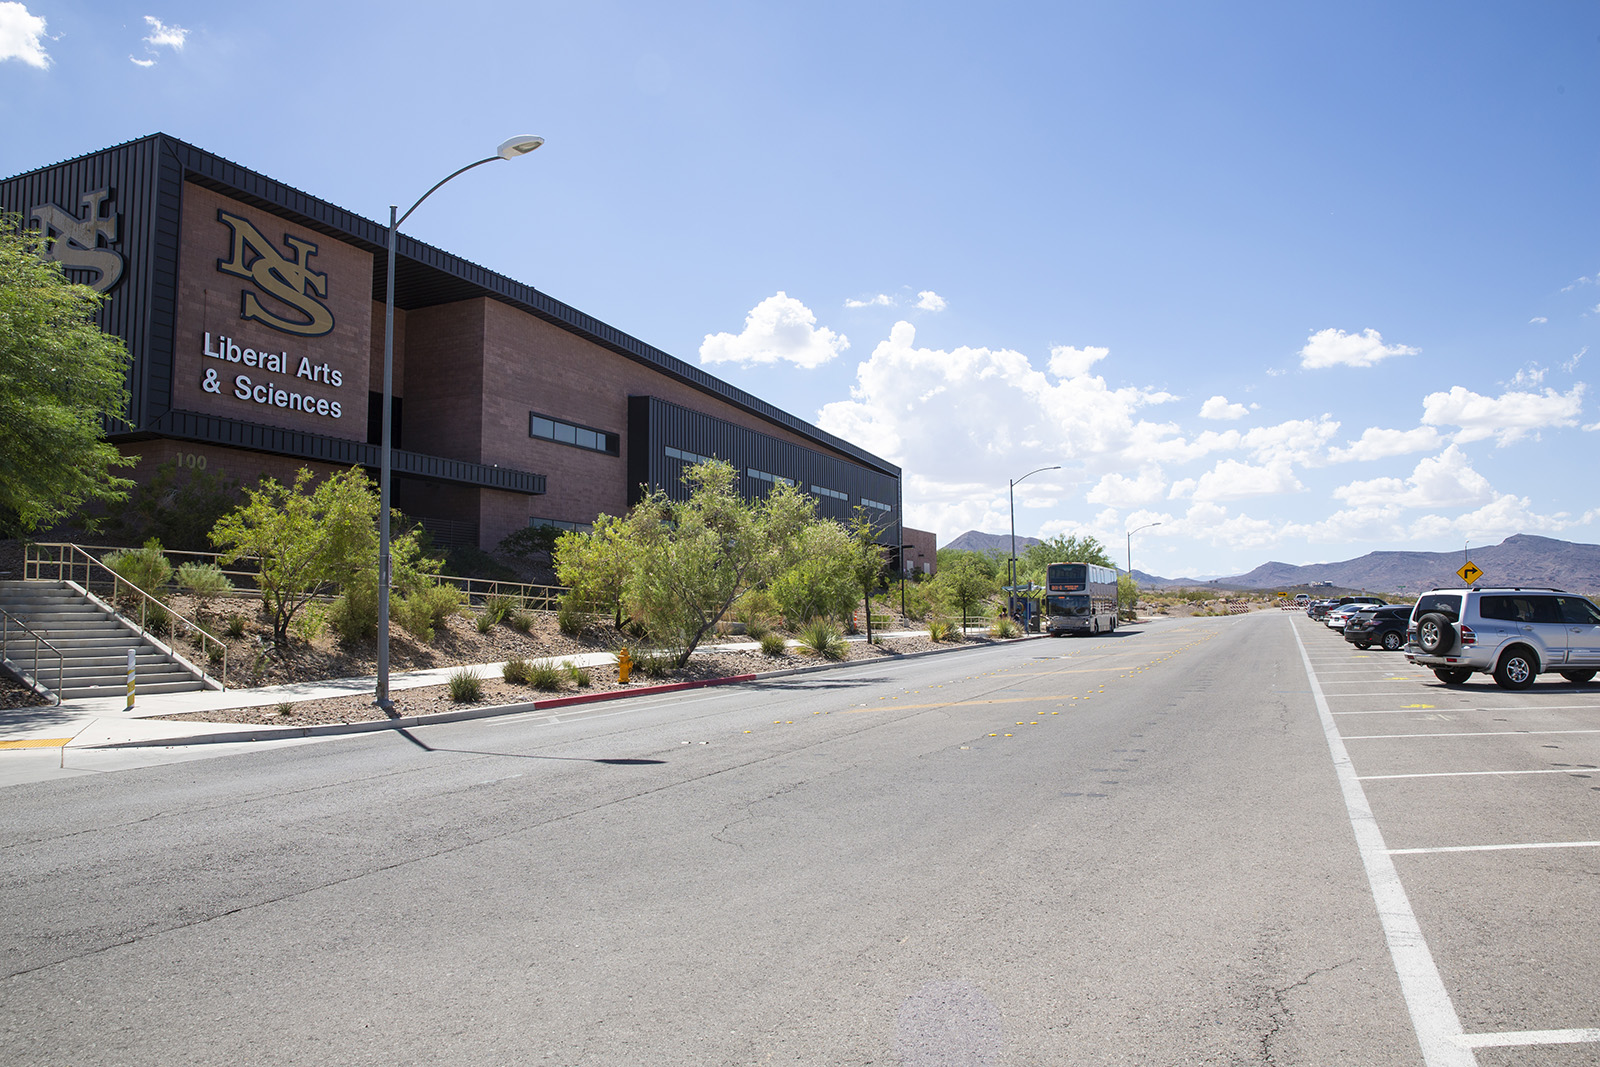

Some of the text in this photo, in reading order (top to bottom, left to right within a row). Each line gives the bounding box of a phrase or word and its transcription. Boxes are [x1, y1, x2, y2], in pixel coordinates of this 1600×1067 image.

[203, 331, 343, 387] Liberal Arts
[202, 368, 342, 419] & Sciences
[176, 452, 207, 470] 100
